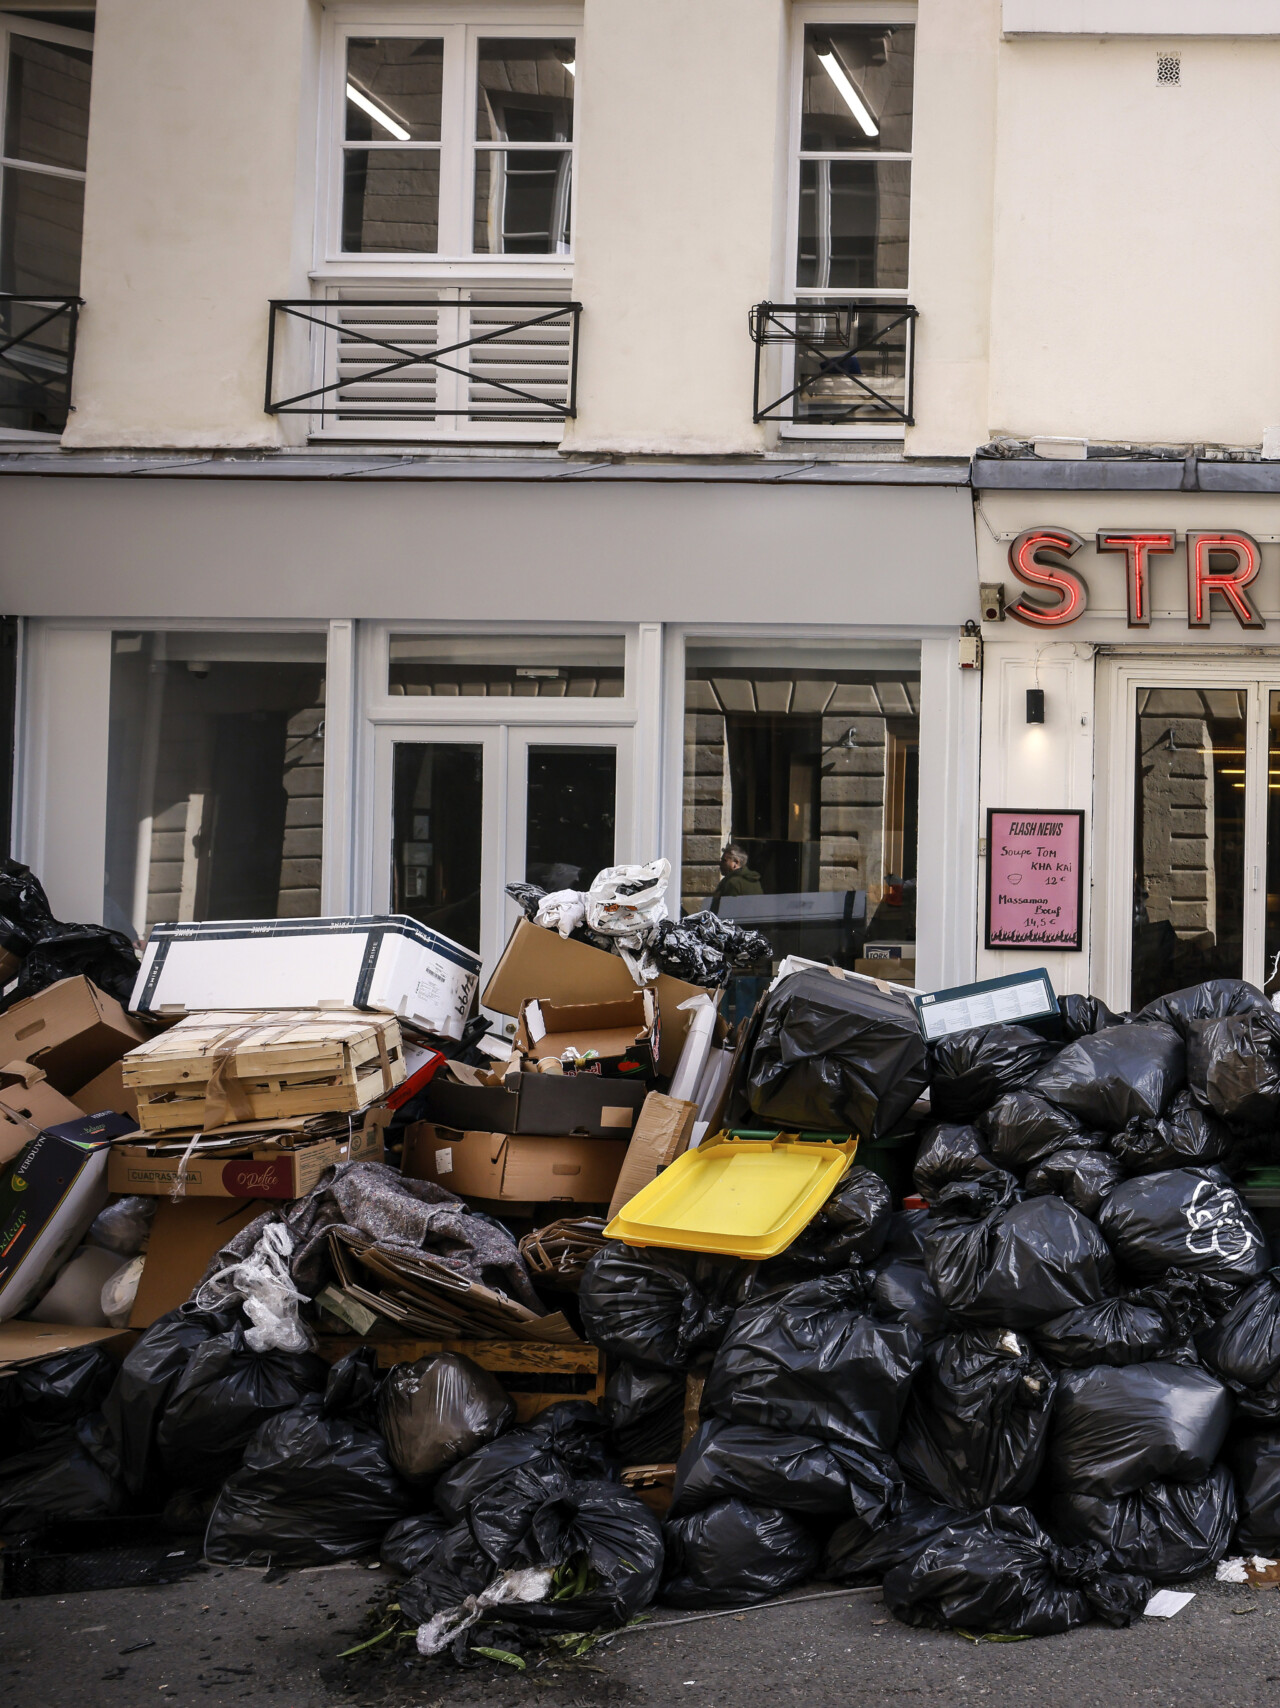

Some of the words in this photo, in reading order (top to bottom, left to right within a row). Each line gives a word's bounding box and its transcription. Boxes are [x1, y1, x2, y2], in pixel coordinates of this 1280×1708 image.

[1009, 822, 1037, 836] FLASH
[1037, 823, 1064, 836] NEWS
[1000, 846, 1032, 858] Soupe
[1031, 861, 1052, 871] KHA
[998, 894, 1049, 905] Massaman
[367, 941, 379, 964] FRIME
[868, 951, 889, 959] TORK
[17, 1135, 47, 1175] VERDUYN
